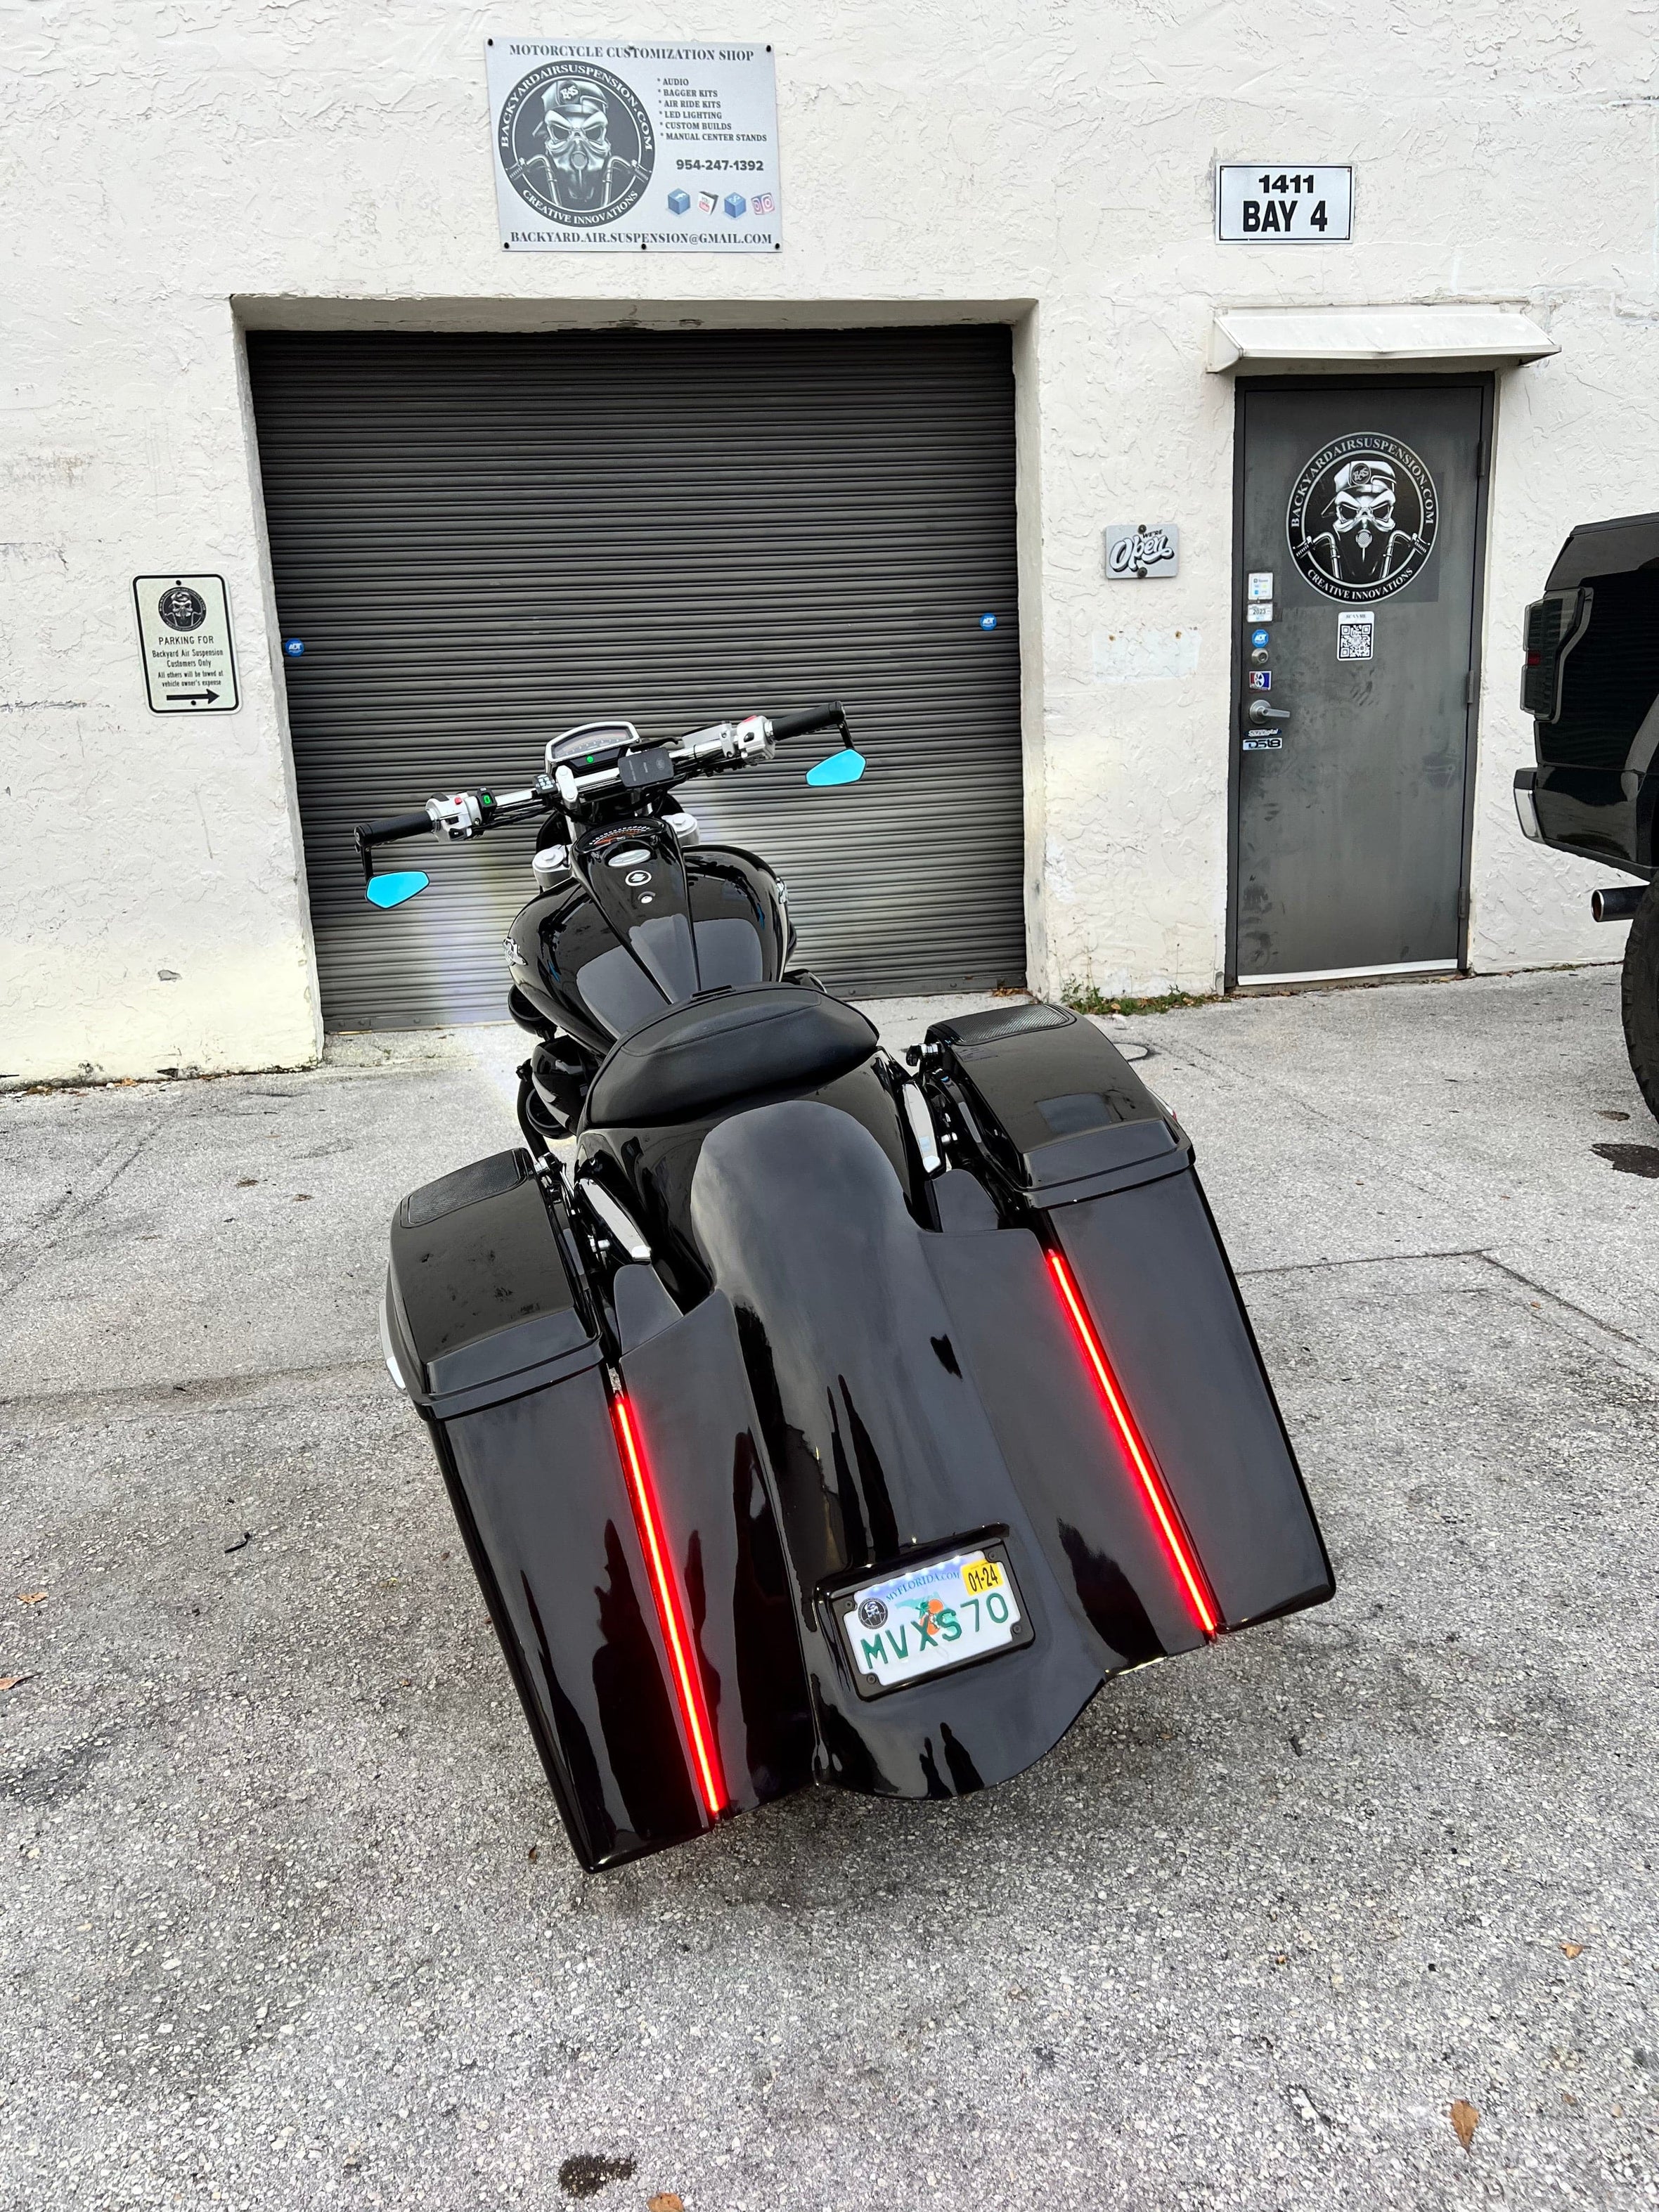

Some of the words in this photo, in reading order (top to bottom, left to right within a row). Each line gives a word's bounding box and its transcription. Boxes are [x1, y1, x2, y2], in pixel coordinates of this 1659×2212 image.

[509, 44, 603, 58] MOTORCYCLE
[606, 46, 715, 60] CUSTOMIZATION
[718, 49, 754, 61] SHOP
[664, 89, 697, 97] BAGGER
[501, 64, 653, 151] BACKYARDAIRSUSPENSION.COM
[676, 159, 763, 171] 954-247-1392
[1258, 174, 1314, 193] 1411
[523, 189, 572, 224] CREATIVE
[574, 190, 638, 224] INNOVATIONS
[1243, 200, 1298, 232] BAY
[1310, 200, 1327, 232] 4
[510, 231, 772, 245] BACKYARD.AIR.SUSPENSION@GMAIL.COM
[1291, 437, 1435, 527] BACKYARDAIRSUSPENSION.COM
[1142, 529, 1163, 538] WE'RE
[1109, 534, 1175, 573] Open
[1308, 569, 1350, 598] CREATIVE
[1352, 567, 1413, 600] INNOVATIONS
[158, 636, 195, 645] PARKING
[198, 635, 214, 644] FOR
[152, 649, 179, 659] Backyard
[192, 649, 224, 658] Suspension
[167, 659, 196, 668] Customers
[198, 659, 211, 668] Only
[886, 1570, 960, 1603] MYFLORIDA.COM
[968, 1564, 998, 1592] 01-24
[860, 1592, 1009, 1669] MVXS70
